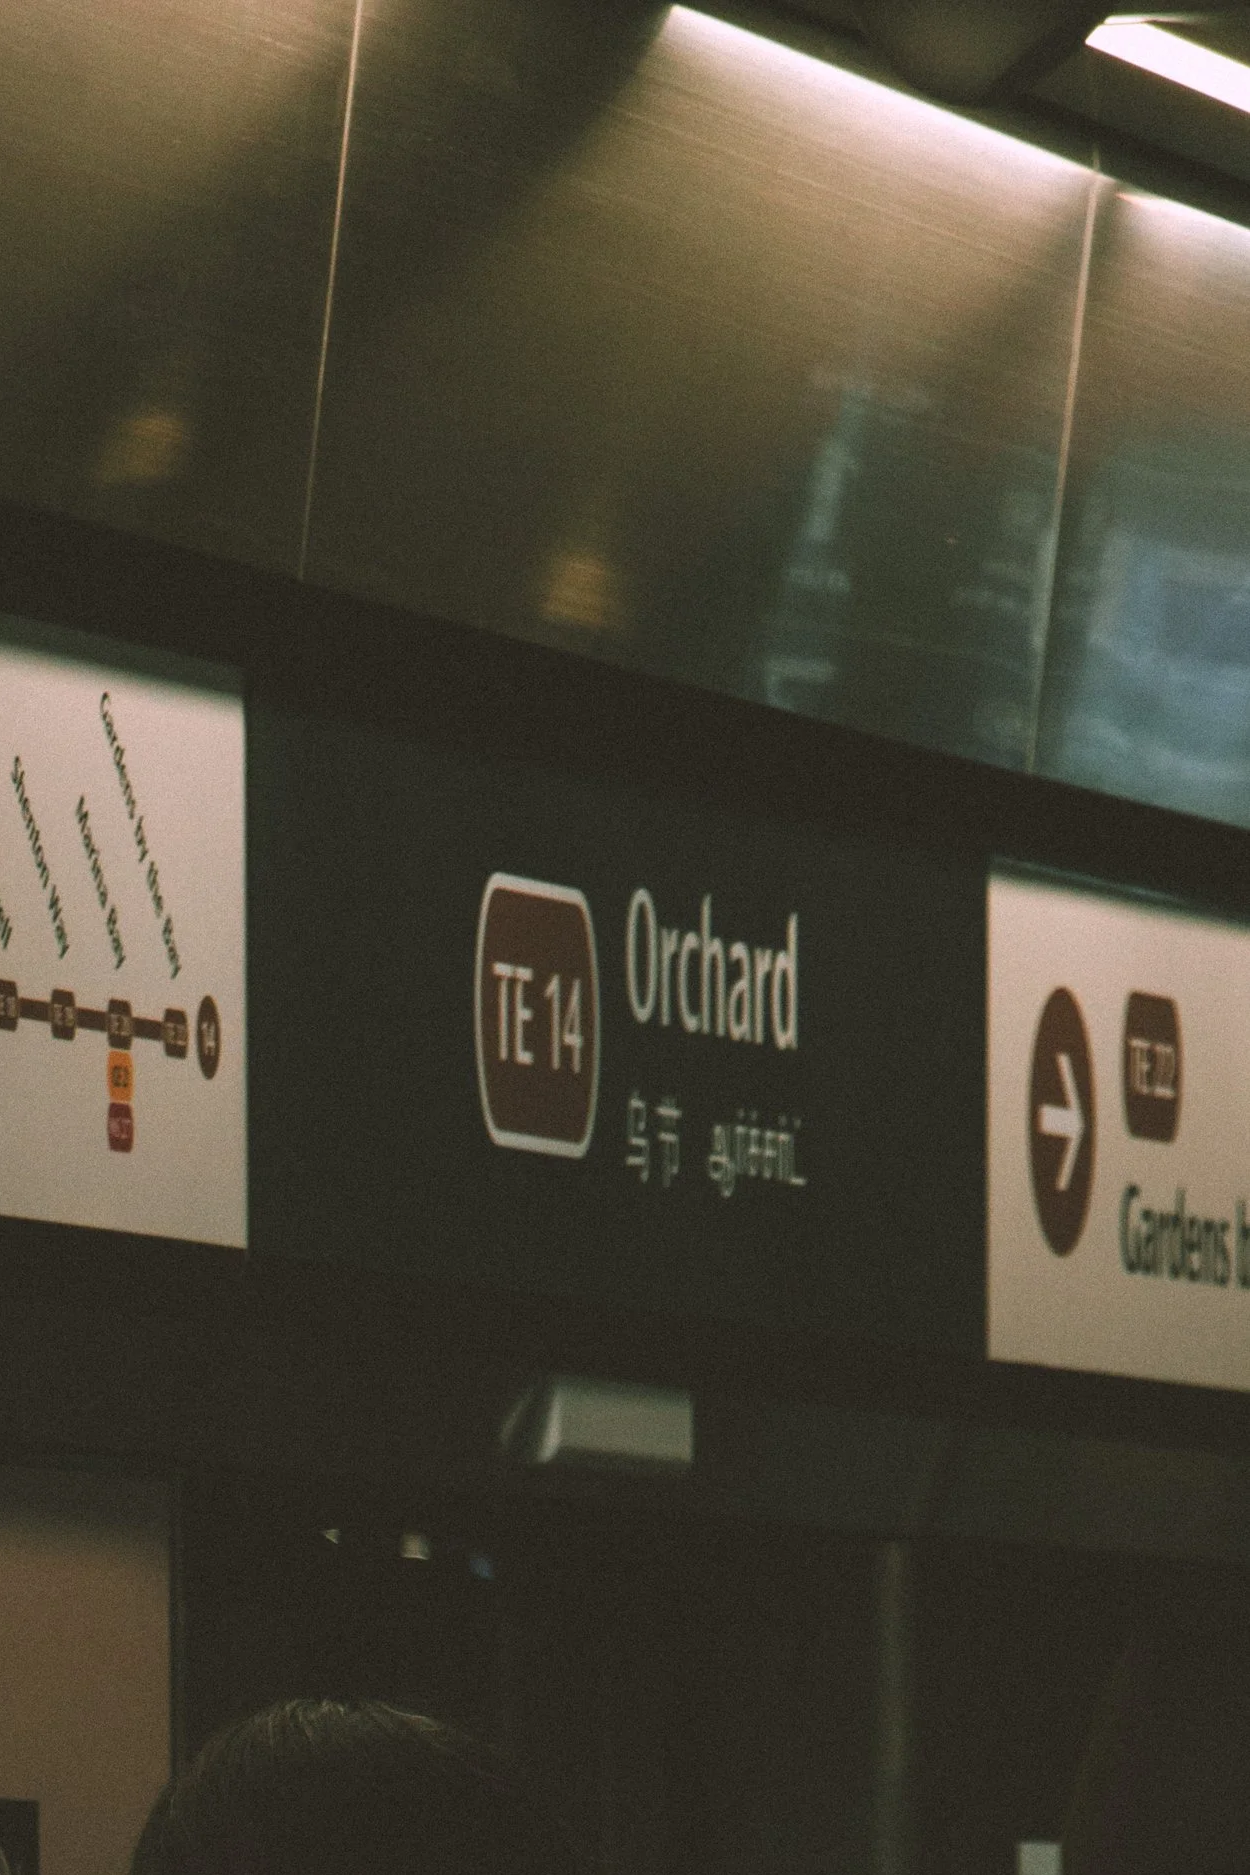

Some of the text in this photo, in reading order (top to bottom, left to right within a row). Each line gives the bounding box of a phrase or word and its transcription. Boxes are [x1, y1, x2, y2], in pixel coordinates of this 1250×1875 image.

[47, 884, 70, 960] Way
[105, 905, 127, 971] Bay
[161, 914, 182, 980] Bay
[626, 888, 799, 1051] Orchard
[492, 961, 583, 1074] TE 14
[625, 1090, 683, 1188] 乌节
[1119, 1182, 1230, 1288] Gardens
